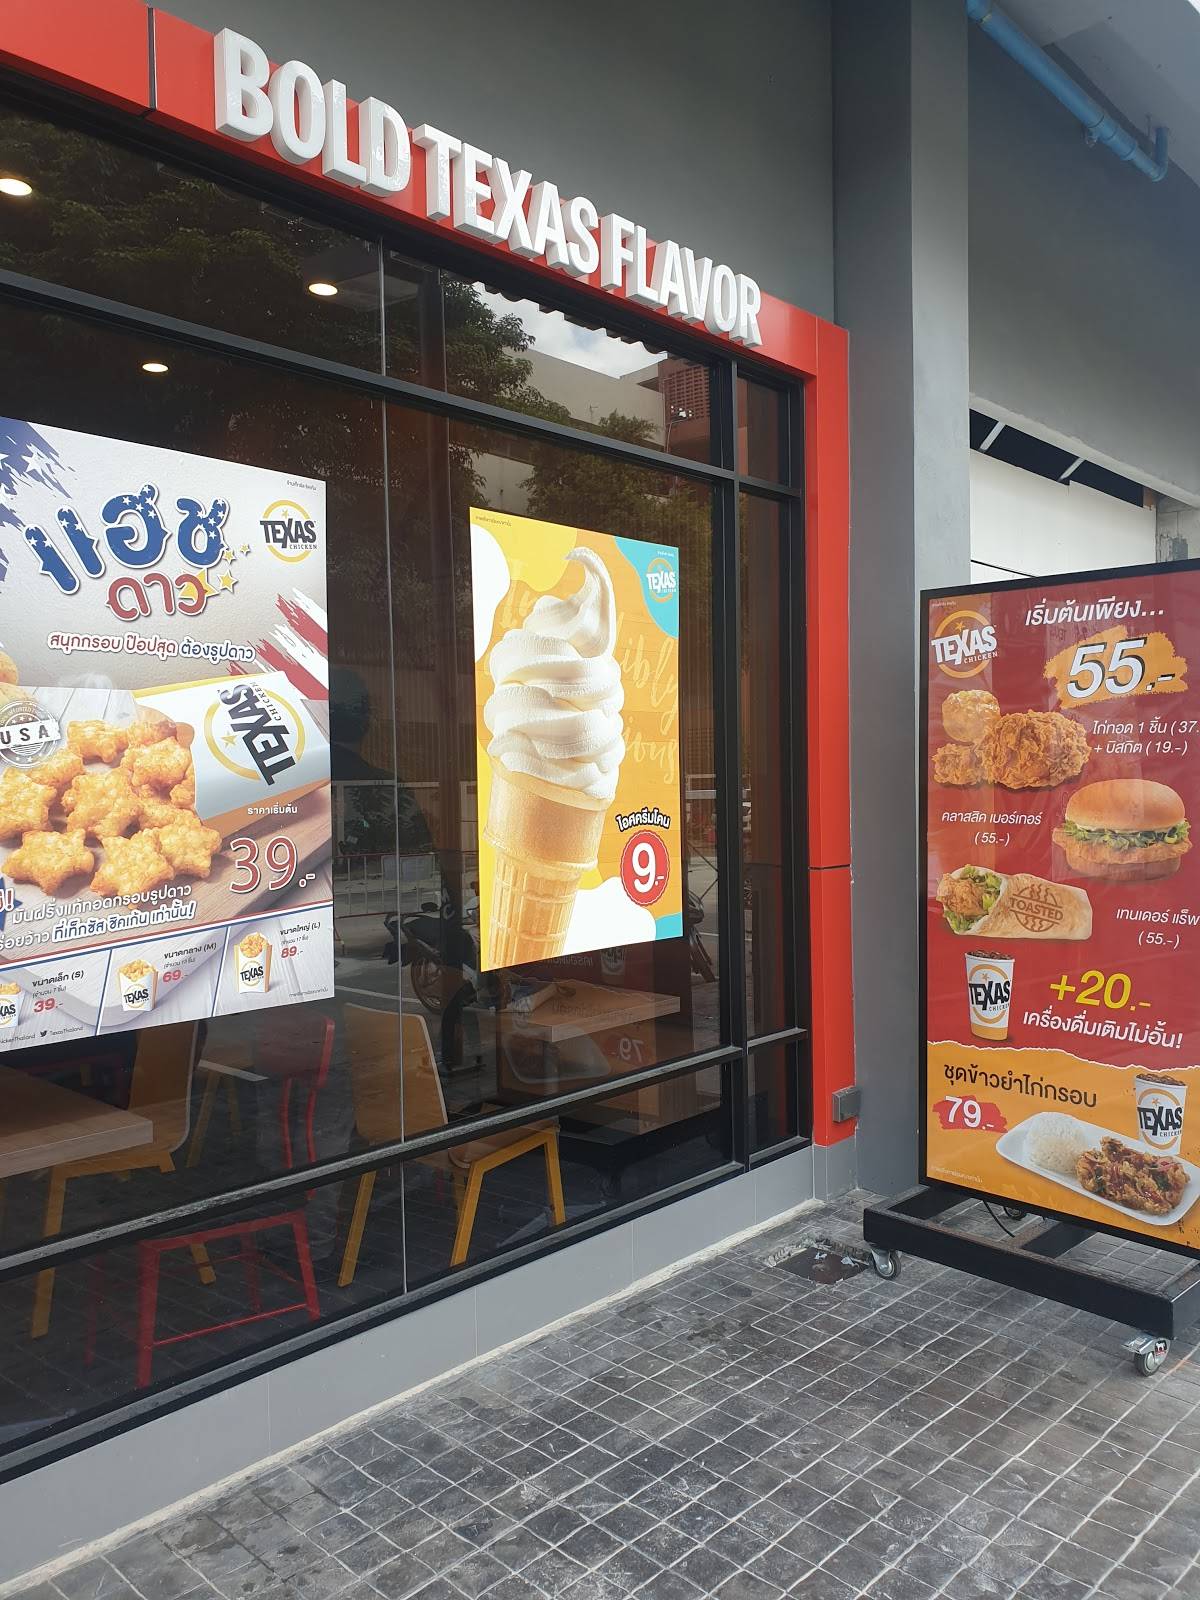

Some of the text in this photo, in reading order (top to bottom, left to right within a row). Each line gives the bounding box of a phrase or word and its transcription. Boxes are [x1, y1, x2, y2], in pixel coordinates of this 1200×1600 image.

[214, 27, 763, 347] BOLD TEXAS FLAVOR
[260, 518, 318, 548] TEXAS
[646, 570, 676, 593] TEXAS
[106, 572, 208, 620] ดาว
[49, 631, 123, 654] สนุกกรอบ
[180, 636, 256, 662] ต้องรูปดาว
[931, 625, 998, 665] TEXAS
[963, 651, 998, 664] CHICKEN
[220, 683, 296, 786] TEXAS
[1092, 719, 1133, 735] ไก่ทอด
[1138, 721, 1144, 734] 1
[1149, 716, 1168, 734] ชิ้น
[1106, 740, 1142, 754] บิสกิต
[247, 804, 298, 816] ราคาเริ่มต้น
[989, 811, 1042, 825] เบอร์เกอร์
[1010, 896, 1064, 921] TOASTED
[1116, 908, 1169, 923] เทนเดอร์
[72, 970, 84, 981] (S)
[240, 965, 264, 982] TEXAS
[123, 989, 148, 1004] TEXAS
[969, 980, 1010, 1010] TEXAS
[944, 1063, 1097, 1108] ชุดข้าวยำไก่กรอบ
[1137, 1106, 1183, 1136] TEXAS
